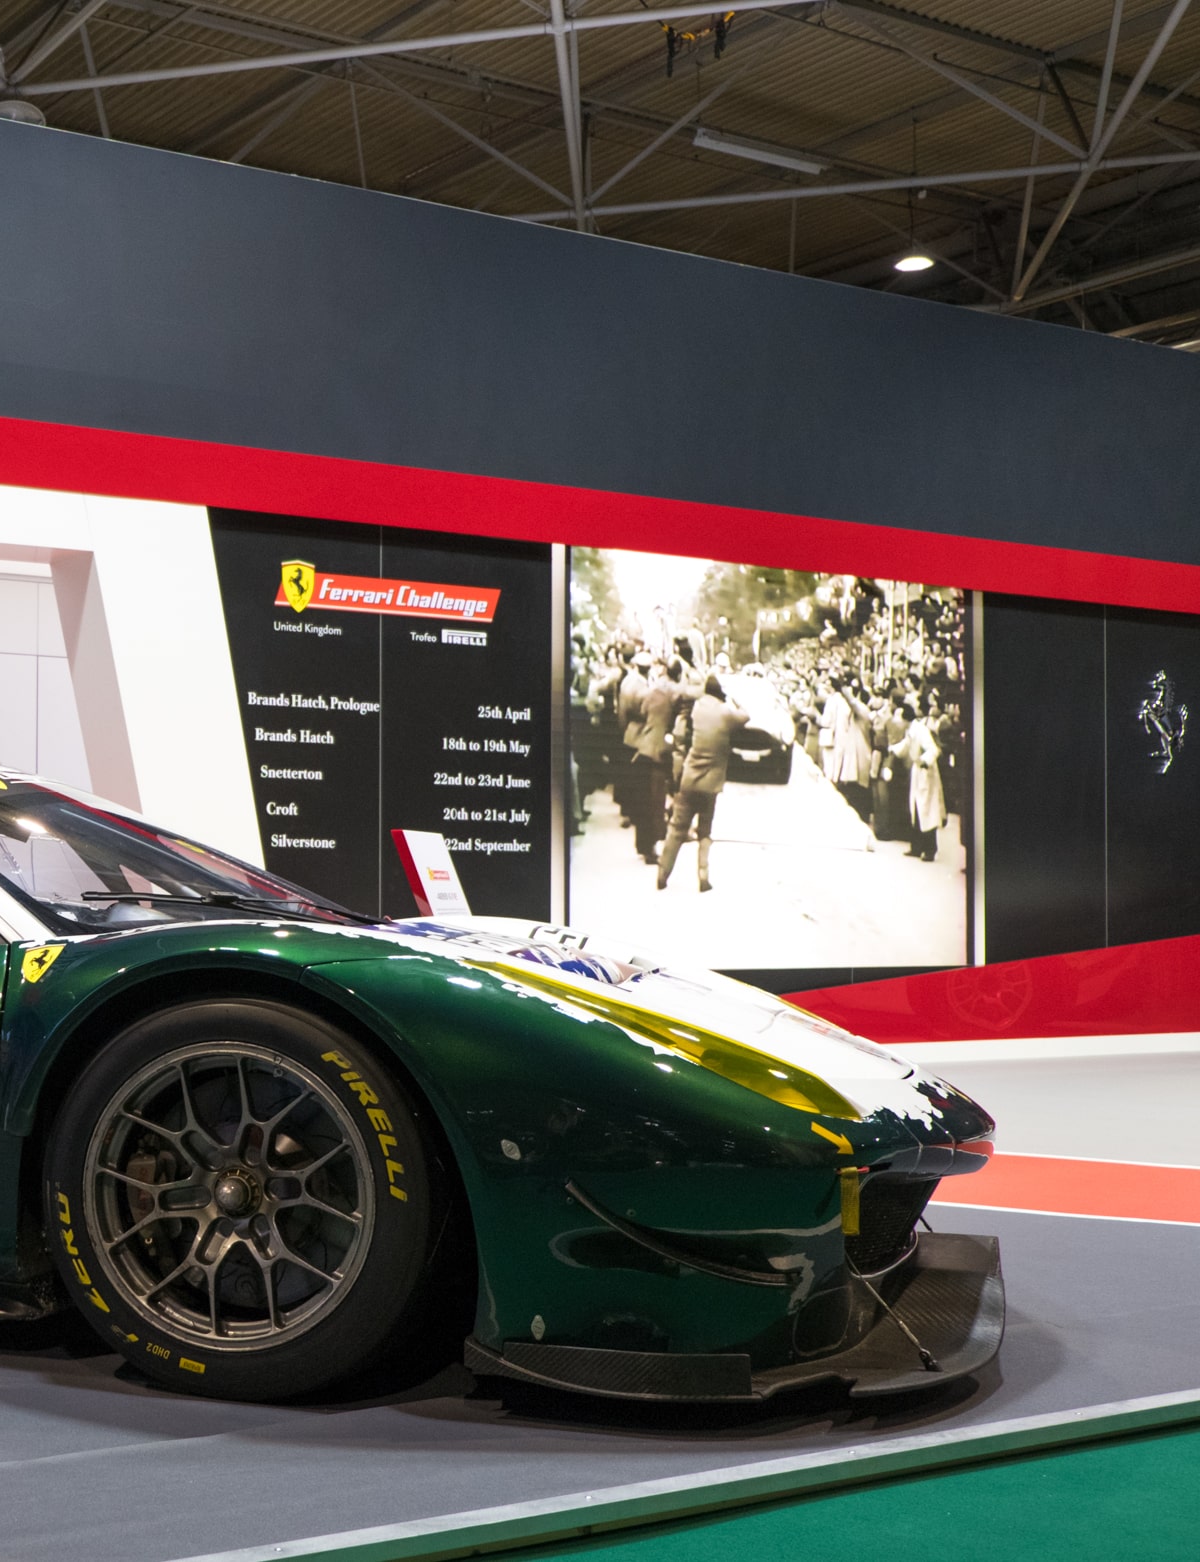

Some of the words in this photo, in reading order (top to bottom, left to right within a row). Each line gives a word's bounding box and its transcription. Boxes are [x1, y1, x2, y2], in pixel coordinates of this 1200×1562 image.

[318, 578, 394, 605] Ferrari
[396, 586, 488, 617] Challenge
[273, 621, 302, 633] United
[304, 624, 342, 637] Kingdom
[410, 631, 437, 643] Trofeo
[441, 628, 487, 646] PIRELLI
[247, 691, 290, 707] Brands
[291, 694, 329, 711] Hatch,
[330, 696, 380, 715] Prologue
[477, 705, 502, 719] 25th
[504, 706, 531, 724] April
[255, 727, 297, 742] Brands
[299, 729, 334, 744] Hatch
[442, 737, 467, 751] 18th
[469, 741, 481, 751] to
[484, 739, 507, 753] 19th
[509, 740, 531, 757] May
[260, 765, 323, 780] Snetterton
[433, 772, 462, 785] 22nd
[464, 775, 476, 786] to
[478, 774, 504, 787] 23rd
[505, 775, 531, 789] June
[266, 801, 298, 816] Croft
[443, 807, 469, 821] 20th
[471, 811, 482, 821] to
[484, 808, 507, 822] 21st
[508, 808, 531, 826] July
[270, 834, 336, 849] Silverstone
[444, 838, 472, 851] 22nd
[474, 838, 531, 856] September
[321, 1050, 408, 1203] PIRELLI
[145, 1342, 171, 1360] DHD2
